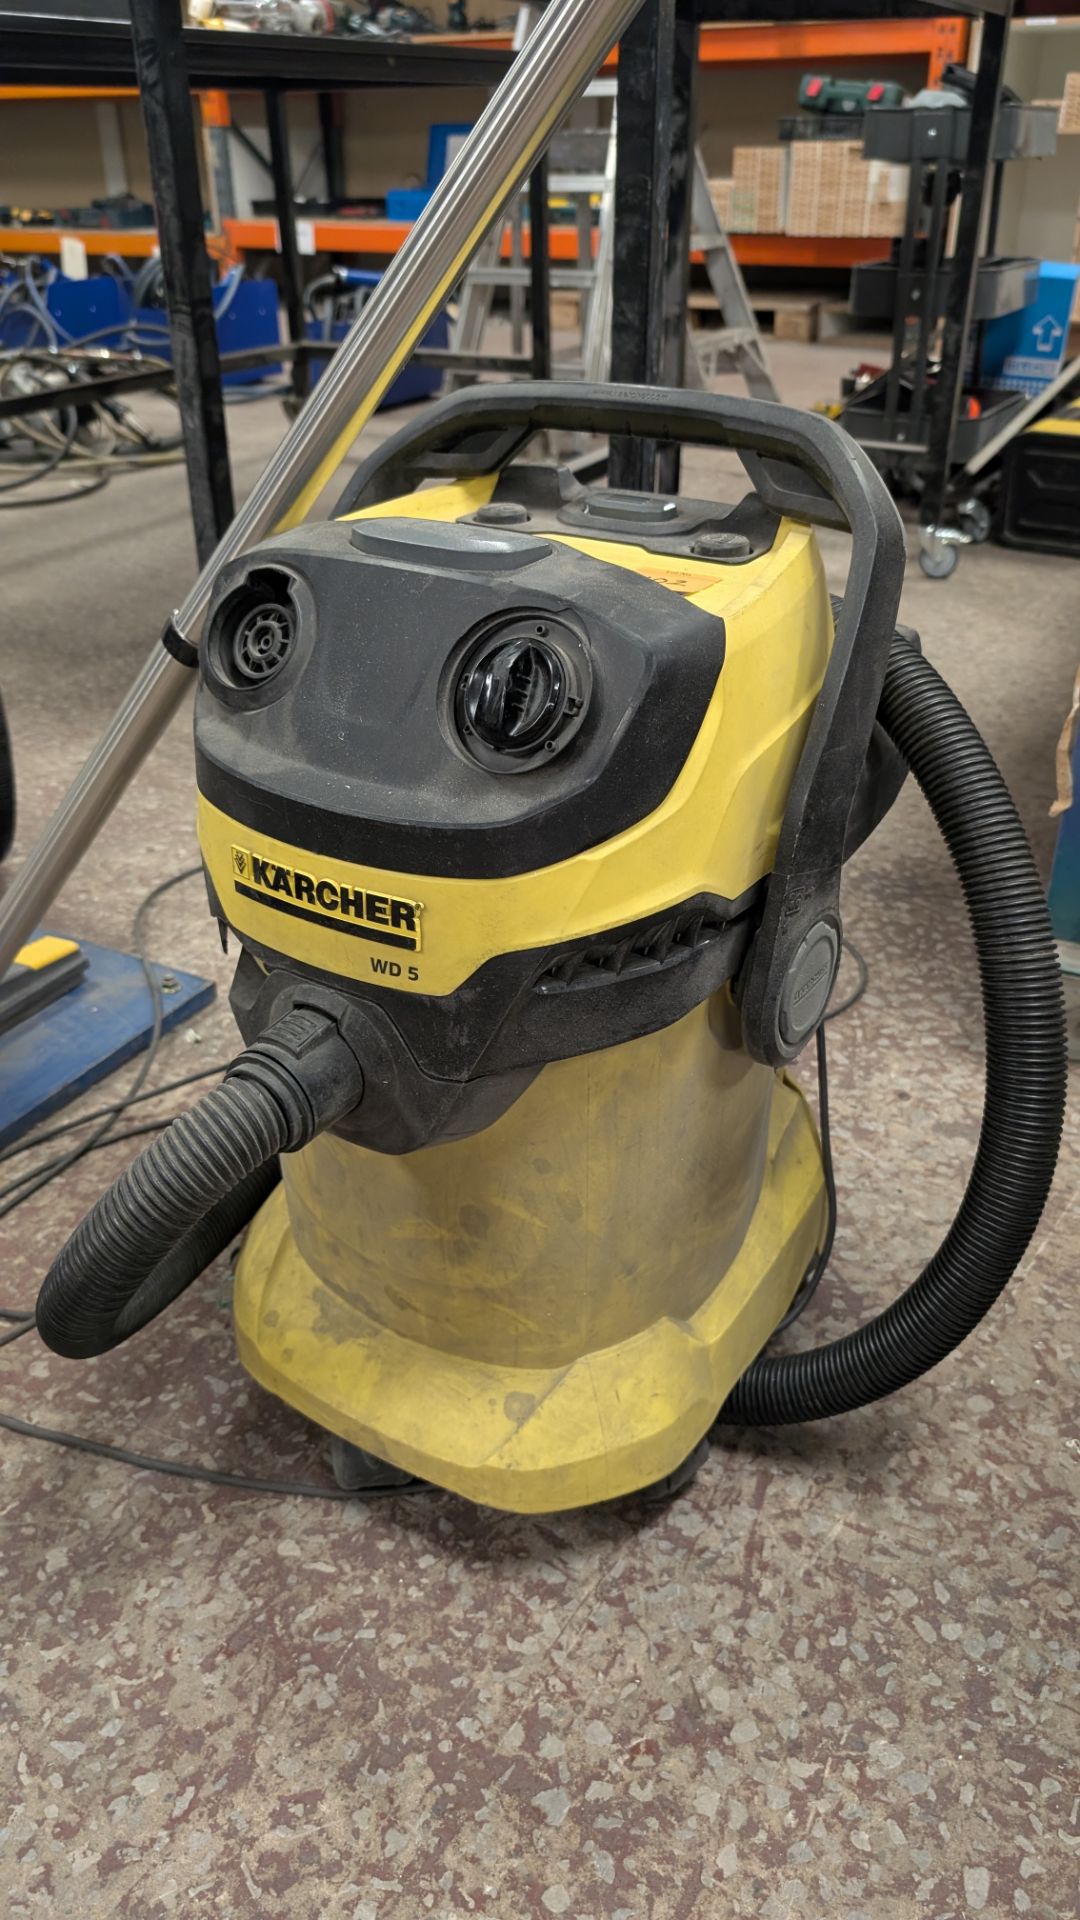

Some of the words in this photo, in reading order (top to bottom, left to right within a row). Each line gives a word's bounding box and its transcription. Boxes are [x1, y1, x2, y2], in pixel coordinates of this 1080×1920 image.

[252, 856, 417, 932] KÄRCHER
[370, 957, 402, 977] WD
[408, 967, 419, 981] 5
